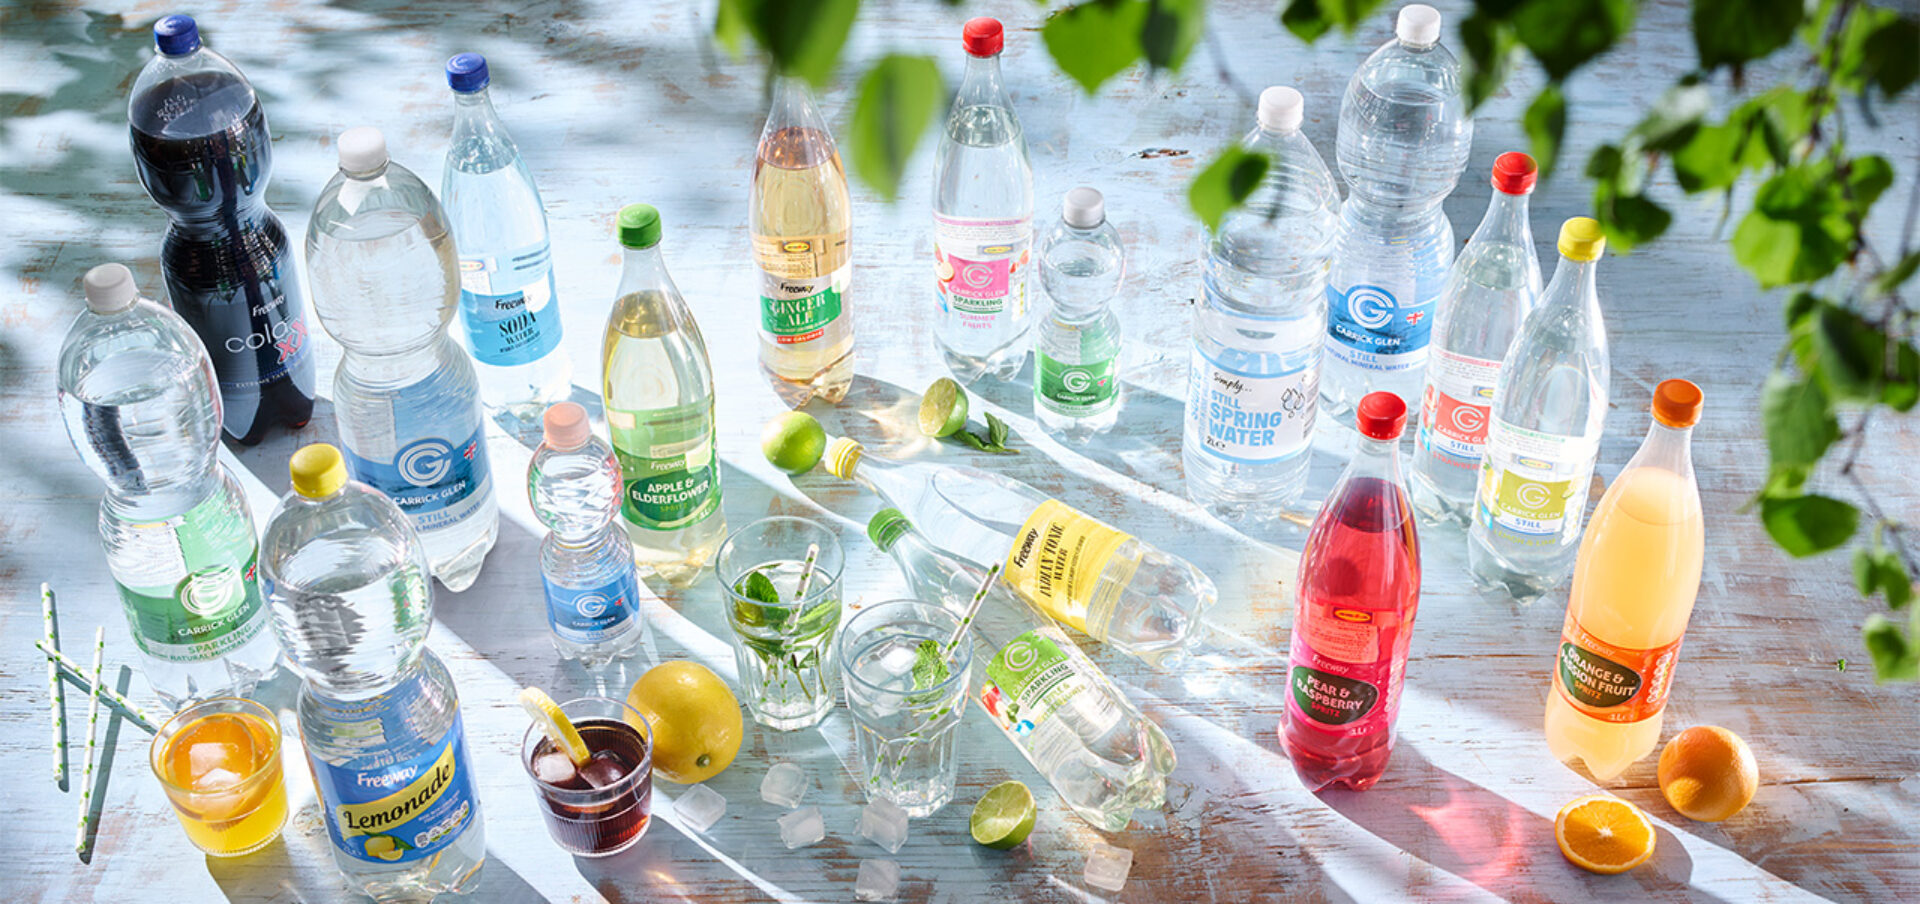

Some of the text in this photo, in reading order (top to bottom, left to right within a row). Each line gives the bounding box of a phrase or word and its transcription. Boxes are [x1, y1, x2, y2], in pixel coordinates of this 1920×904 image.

[780, 281, 815, 295] Freeway
[252, 294, 286, 317] Freeway
[770, 293, 826, 314] GINGER
[952, 294, 1004, 307] SPARKLING
[498, 310, 537, 337] SODA
[787, 309, 815, 327] ALE
[1335, 324, 1401, 346] CARRICK GLEN
[1349, 349, 1378, 363] STILL
[1211, 389, 1242, 410] STILL
[1210, 401, 1283, 429] SPRING
[1208, 418, 1276, 447] WATER
[1437, 424, 1470, 442] CARRICK
[1450, 440, 1476, 452] STILL
[650, 458, 685, 472] Freeway
[393, 479, 467, 507] CARRICK GLEN
[631, 479, 710, 505] ELDERFLOWER
[647, 477, 695, 495] APPLE &
[417, 509, 451, 525] STILL
[422, 512, 459, 532] MINERAL
[459, 501, 482, 520] WATER
[1500, 502, 1561, 520] CARRICK GLEN
[1514, 517, 1542, 529] STILL
[1012, 527, 1040, 569] Freeway
[1038, 521, 1066, 598] INDIAN TONIC
[1053, 548, 1069, 581] WATER
[177, 602, 251, 637] CARRICK GLEN
[187, 623, 252, 655] SPARKLING
[1581, 632, 1616, 657] Freeway
[169, 652, 210, 662] NATURAL
[1312, 654, 1350, 674] Freeway
[1567, 646, 1612, 682] ORANGE
[1612, 673, 1625, 684] &
[1012, 668, 1042, 697] CARRICK
[1021, 662, 1070, 703] SPARKLING
[1295, 677, 1364, 711] RASPBERRY
[1306, 674, 1351, 699] PEAR &
[1574, 679, 1602, 700] SPRITZ
[1597, 680, 1637, 697] FRUIT
[1310, 701, 1341, 718] SPRITZ
[356, 764, 420, 789] Freeway
[342, 763, 451, 831] Lemonade
